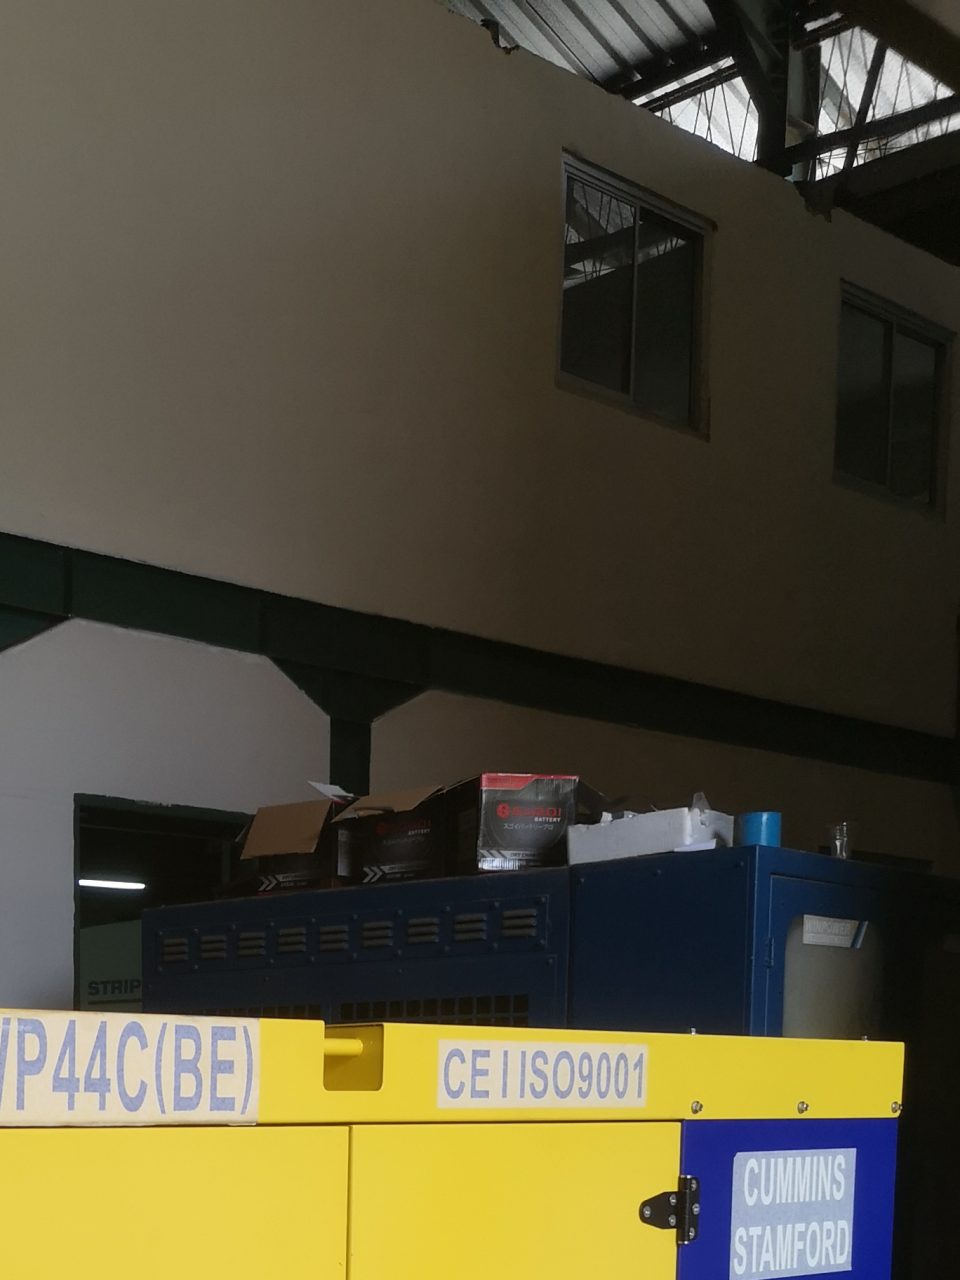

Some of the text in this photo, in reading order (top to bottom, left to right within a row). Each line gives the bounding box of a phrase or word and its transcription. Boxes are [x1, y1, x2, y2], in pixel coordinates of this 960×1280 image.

[443, 1048, 490, 1099] CE
[519, 1050, 644, 1099] ISO9001
[744, 1154, 845, 1207] CUMMINS
[733, 1219, 850, 1275] STAMFORD
